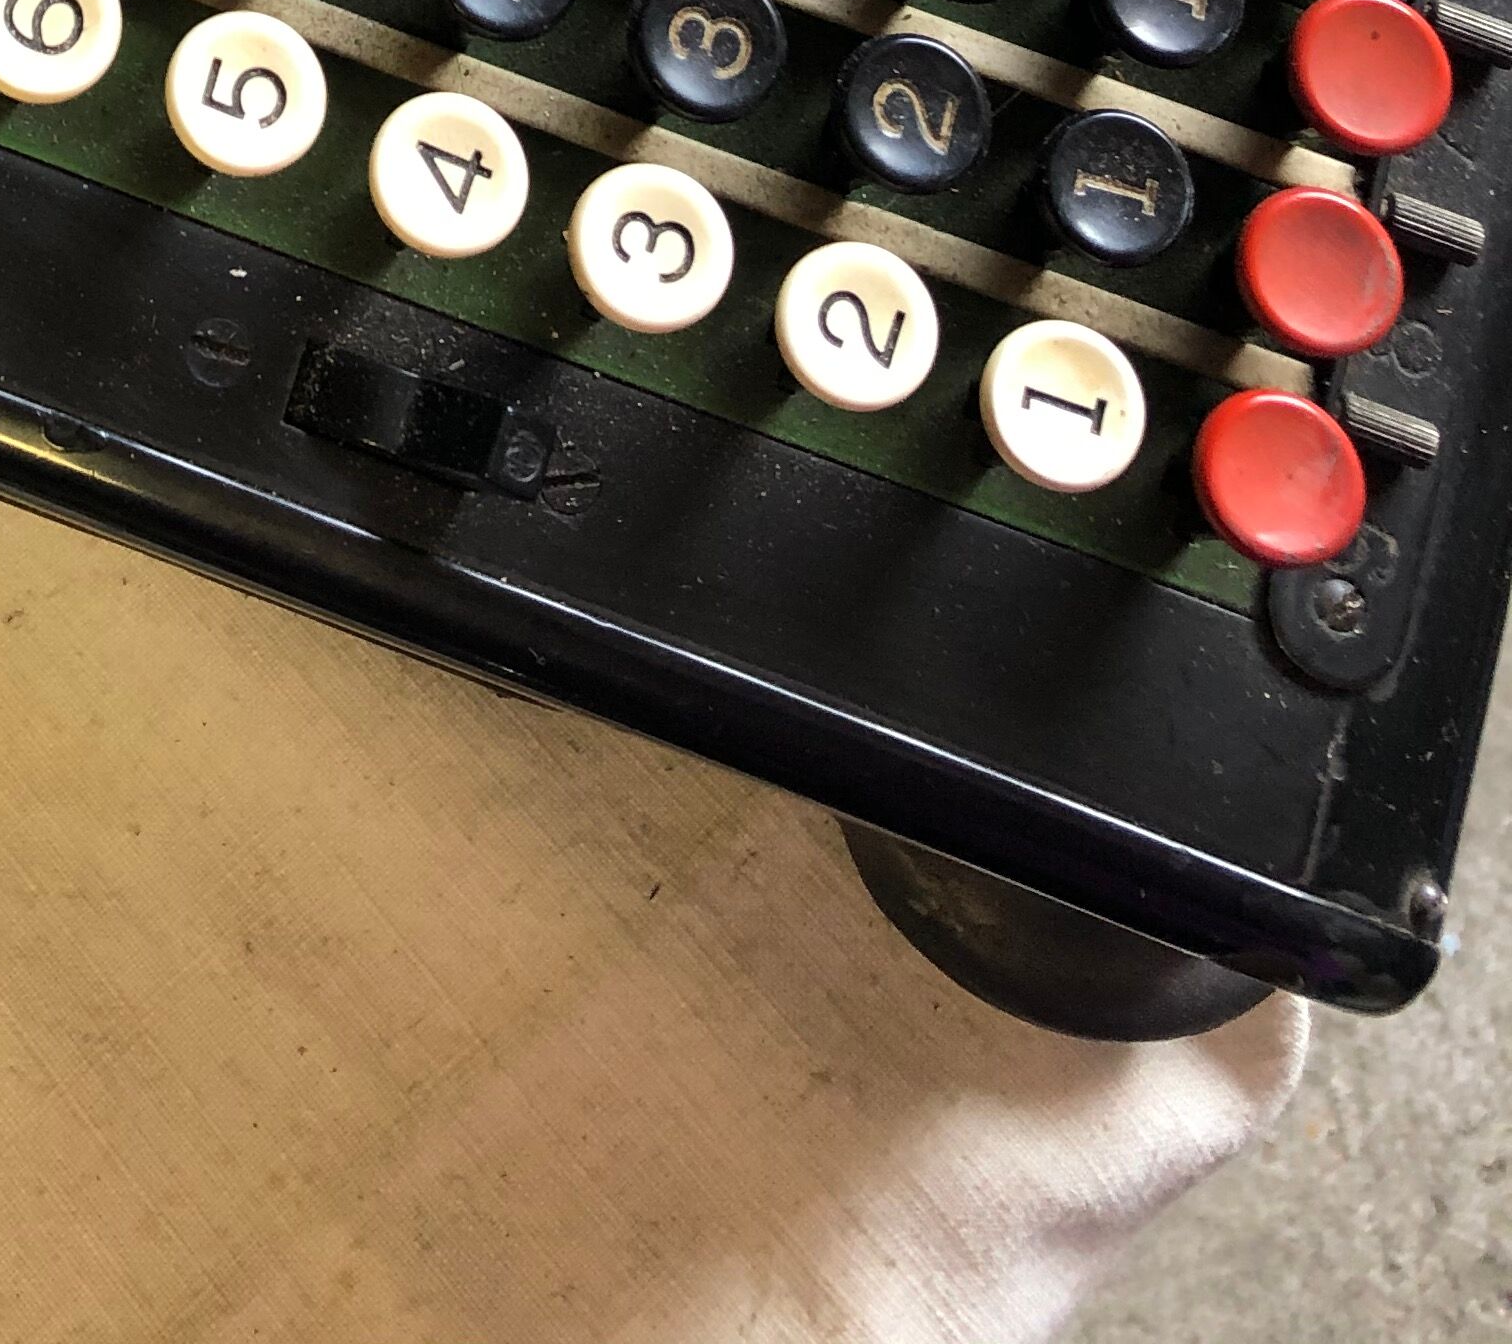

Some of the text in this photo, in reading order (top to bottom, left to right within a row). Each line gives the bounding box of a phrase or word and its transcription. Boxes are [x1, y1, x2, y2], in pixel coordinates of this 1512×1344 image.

[668, 5, 753, 80] 3
[202, 57, 288, 129] 5
[873, 78, 960, 156] 2
[418, 139, 493, 213] 4
[1074, 167, 1160, 217] 1
[612, 210, 696, 285] 3
[818, 291, 907, 369] 2
[1021, 386, 1108, 437] 1
